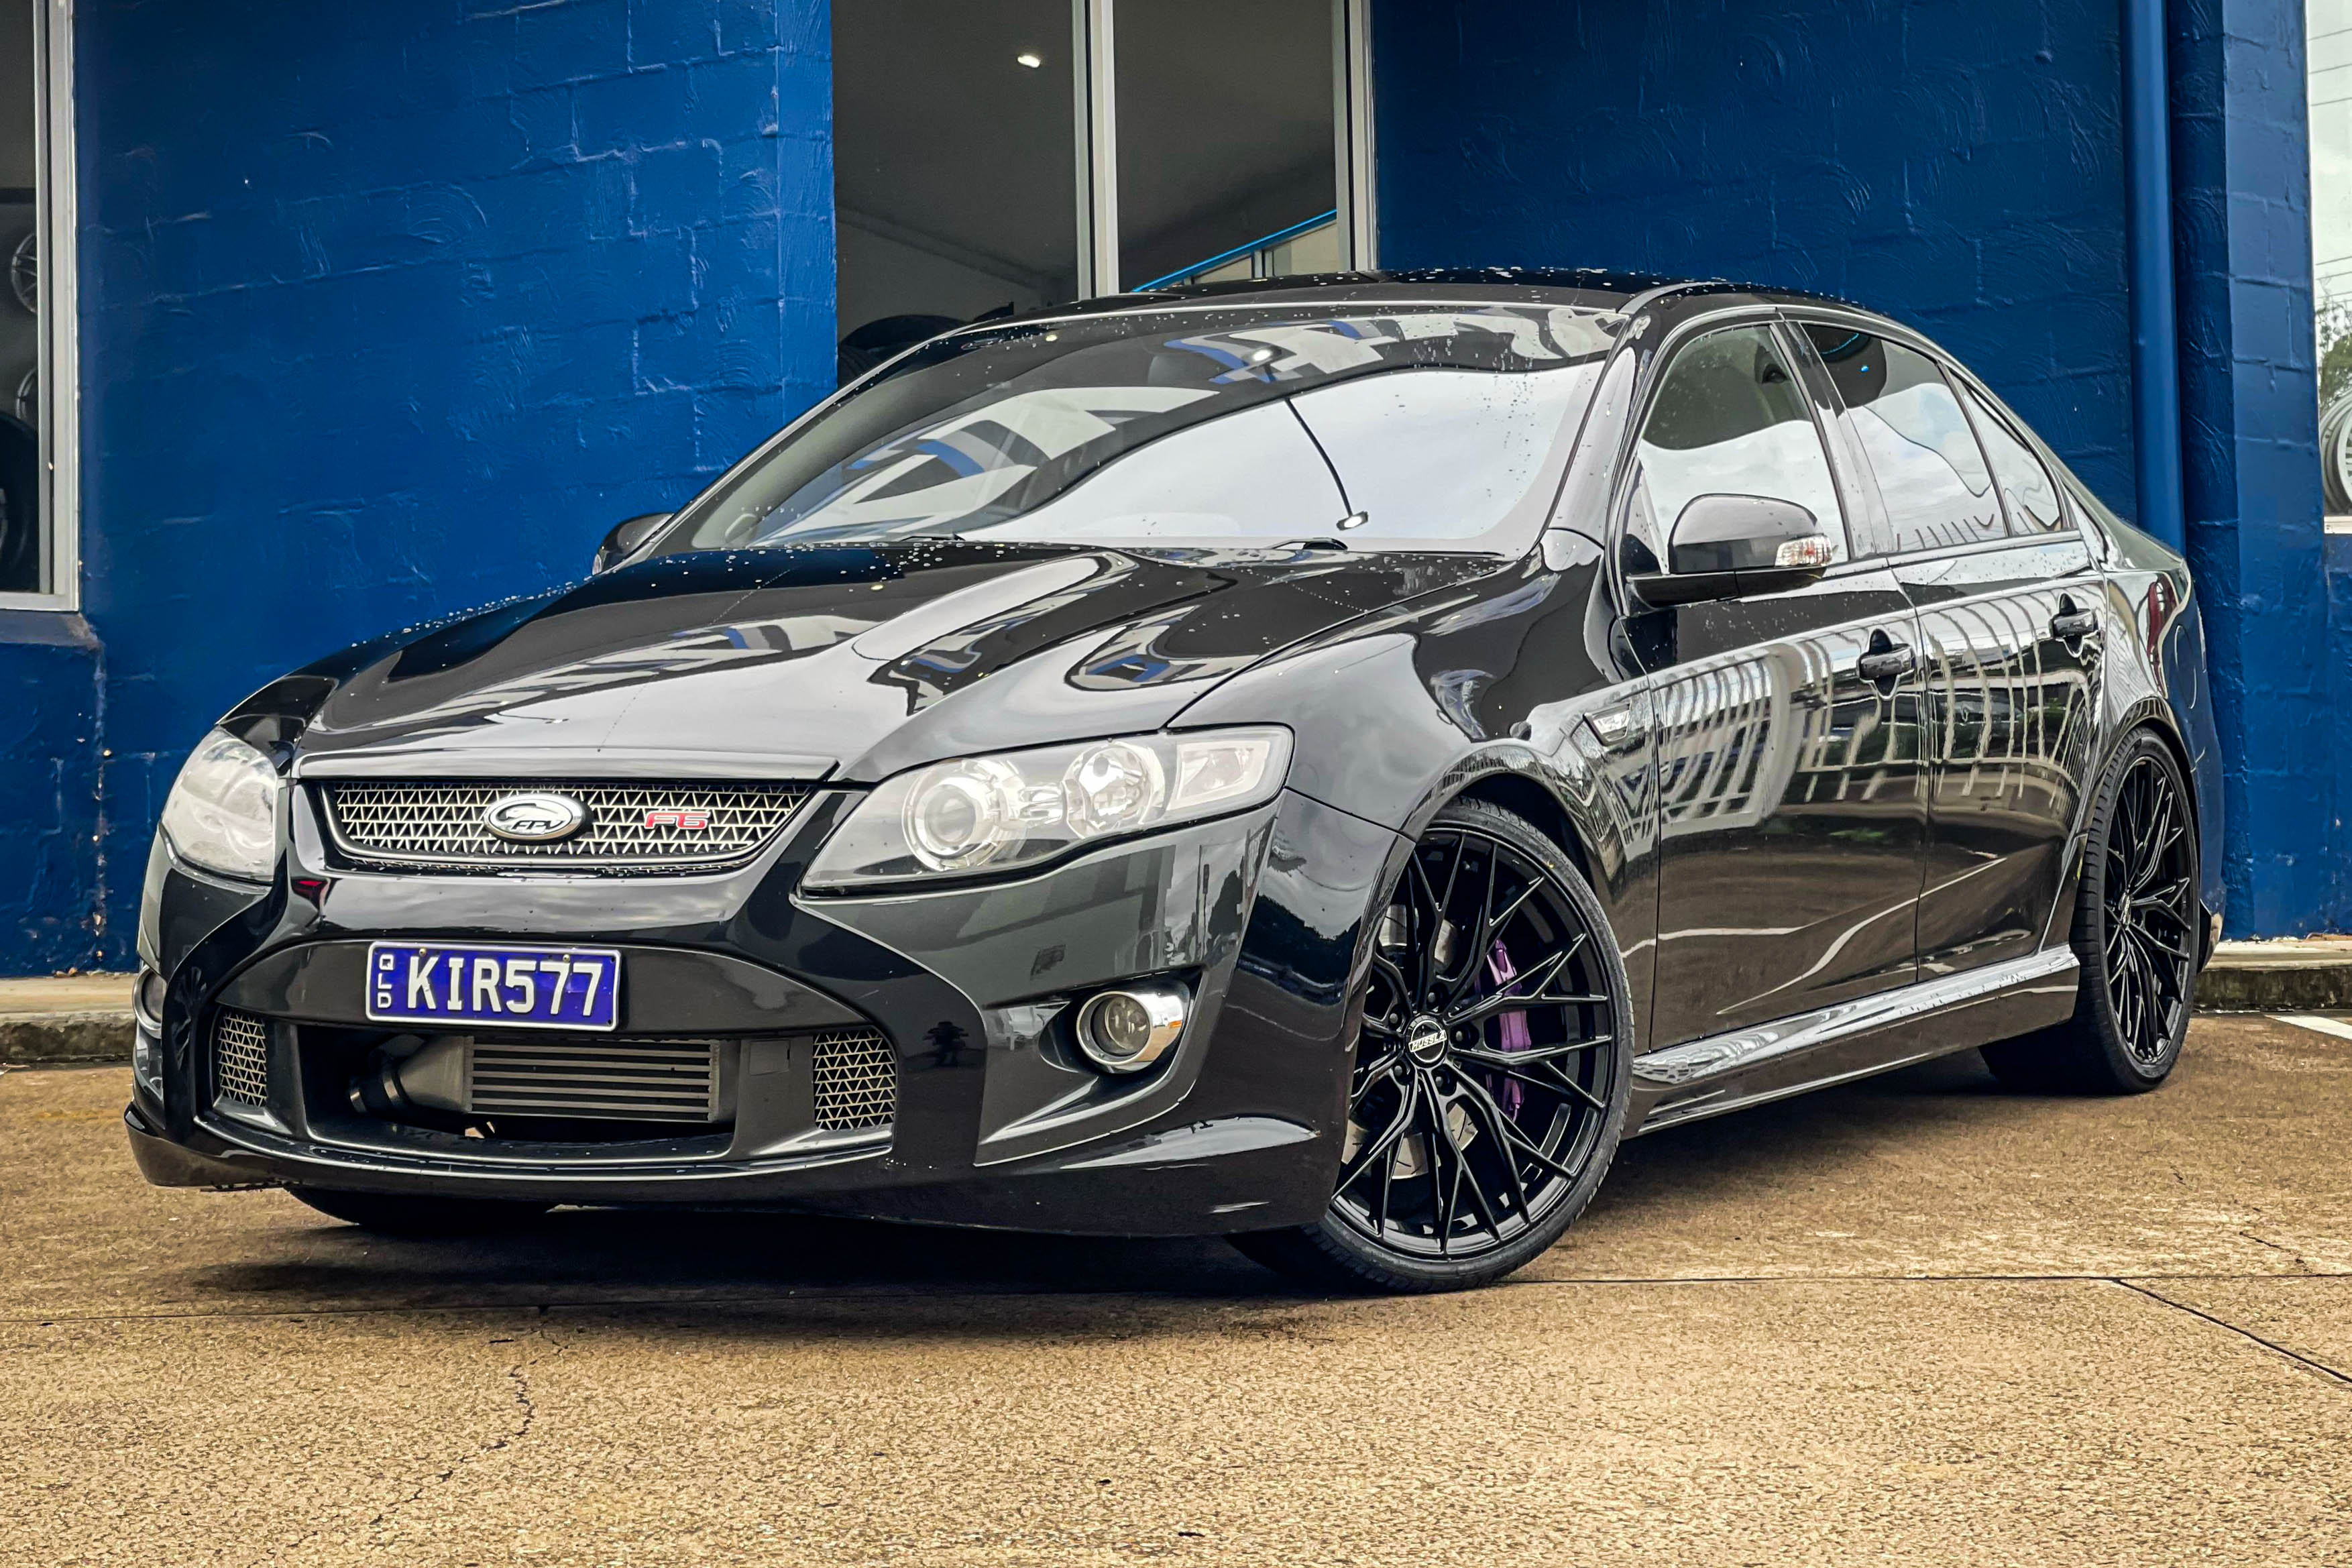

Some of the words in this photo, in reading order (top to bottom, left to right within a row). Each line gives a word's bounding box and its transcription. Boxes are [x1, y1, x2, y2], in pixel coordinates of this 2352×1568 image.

[511, 820, 565, 830] FPV
[644, 811, 711, 830] F6
[378, 954, 394, 1009] QLD
[407, 956, 603, 1017] KIR577
[1410, 1030, 1447, 1051] HUSSLA
